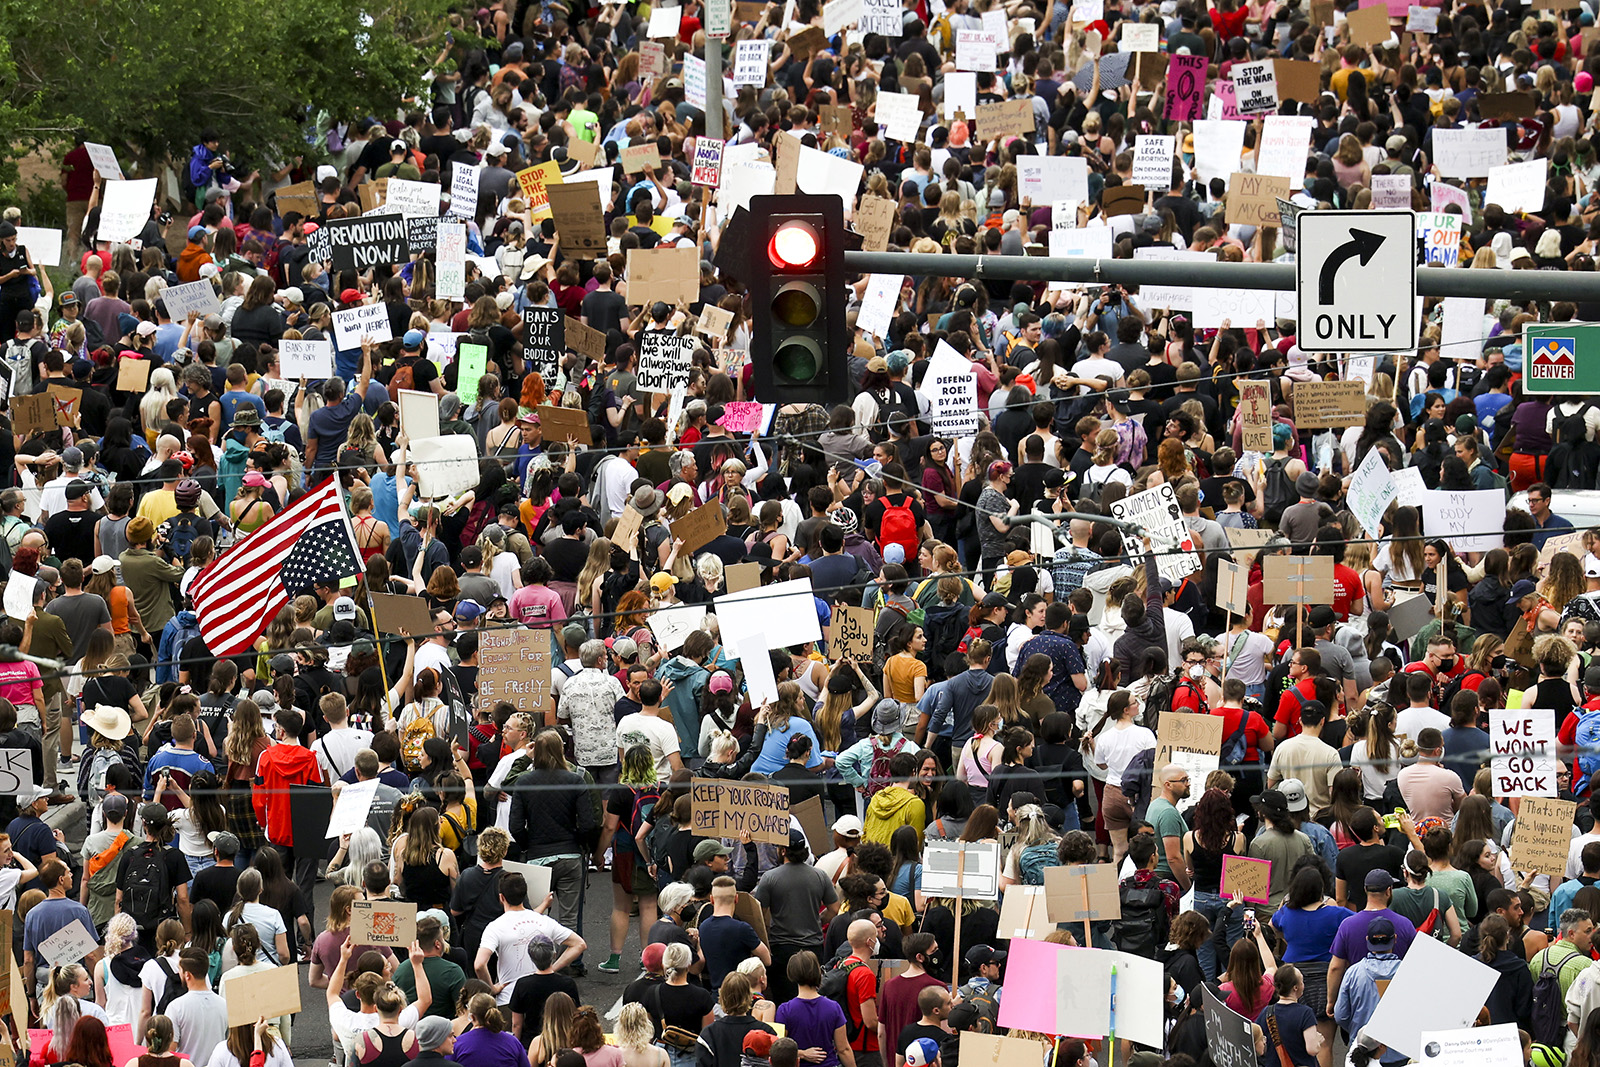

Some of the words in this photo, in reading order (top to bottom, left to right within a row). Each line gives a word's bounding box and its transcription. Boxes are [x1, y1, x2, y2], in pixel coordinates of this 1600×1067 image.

[1177, 56, 1203, 69] THIS
[1242, 66, 1264, 78] STOP
[1236, 77, 1251, 88] THE
[1253, 74, 1273, 85] WAR
[1251, 90, 1262, 99] ON
[1242, 95, 1273, 109] WOMEN!
[1145, 138, 1164, 146] SAFE
[459, 166, 473, 177] SAFE
[519, 168, 548, 185] STOP.
[456, 175, 474, 187] LEGAL
[1240, 177, 1261, 193] MY
[453, 183, 477, 195] ABORTION
[529, 195, 550, 208] BAN
[1237, 202, 1257, 218] MY
[1434, 215, 1455, 229] UR
[306, 233, 318, 246] MY
[331, 220, 404, 248] REVOLUTION
[1433, 231, 1460, 245] OUT
[317, 238, 330, 250] MY
[352, 244, 399, 268] NOW!
[165, 280, 206, 300] ABORTION
[337, 312, 355, 324] PRO
[525, 311, 559, 324] BANS
[529, 323, 553, 336] OFF
[1315, 314, 1396, 340] ONLY
[285, 341, 302, 352] BANS
[530, 334, 552, 346] OUR
[661, 334, 694, 351] SCOTUS
[524, 347, 557, 362] BODIES
[642, 344, 660, 358] we
[663, 349, 681, 362] will
[641, 357, 671, 373] always
[671, 359, 692, 374] have
[1351, 358, 1369, 368] FUCK
[1532, 364, 1574, 379] DENVER
[937, 374, 972, 385] DEFEND
[942, 386, 967, 395] ROE!
[1297, 384, 1307, 392] IF
[1310, 383, 1321, 391] YOU
[938, 398, 951, 406] BY
[952, 396, 973, 406] ANY
[941, 409, 971, 418] MEANS
[1243, 412, 1269, 425] HEALTH
[725, 421, 745, 432] BODY
[933, 418, 978, 428] NECESSARY!
[1245, 433, 1269, 448] CARE
[1351, 477, 1364, 495] YOU
[1362, 456, 1378, 477] ARE
[1381, 480, 1396, 501] ONE
[1124, 491, 1161, 517] WOMEN
[1450, 494, 1466, 507] MY
[1439, 507, 1473, 521] BODY
[1450, 521, 1466, 535] MY
[836, 609, 857, 630] My
[841, 625, 868, 647] Body
[833, 638, 850, 652] My
[520, 648, 545, 661] FOR
[481, 680, 496, 697] BE
[505, 679, 547, 696] FREELY
[1168, 718, 1220, 746] BODY
[1502, 718, 1533, 737] WE
[1494, 739, 1549, 756] WONT
[1508, 757, 1534, 773] GO
[1497, 776, 1547, 793] BACK
[692, 781, 725, 803] KEEP
[729, 784, 752, 803] YOUR
[754, 788, 790, 812] ROSARIES
[694, 810, 720, 827] OFF
[723, 810, 746, 832] MY
[748, 813, 790, 838] OVARIES
[1518, 818, 1530, 831] the
[1534, 822, 1564, 836] WOMEN
[1515, 834, 1529, 844] are
[1225, 861, 1249, 875] Women
[1511, 860, 1526, 872] Amy
[1229, 866, 1258, 882] Deserve
[1211, 1008, 1223, 1031] I'M
[1216, 1031, 1241, 1065] WITH
